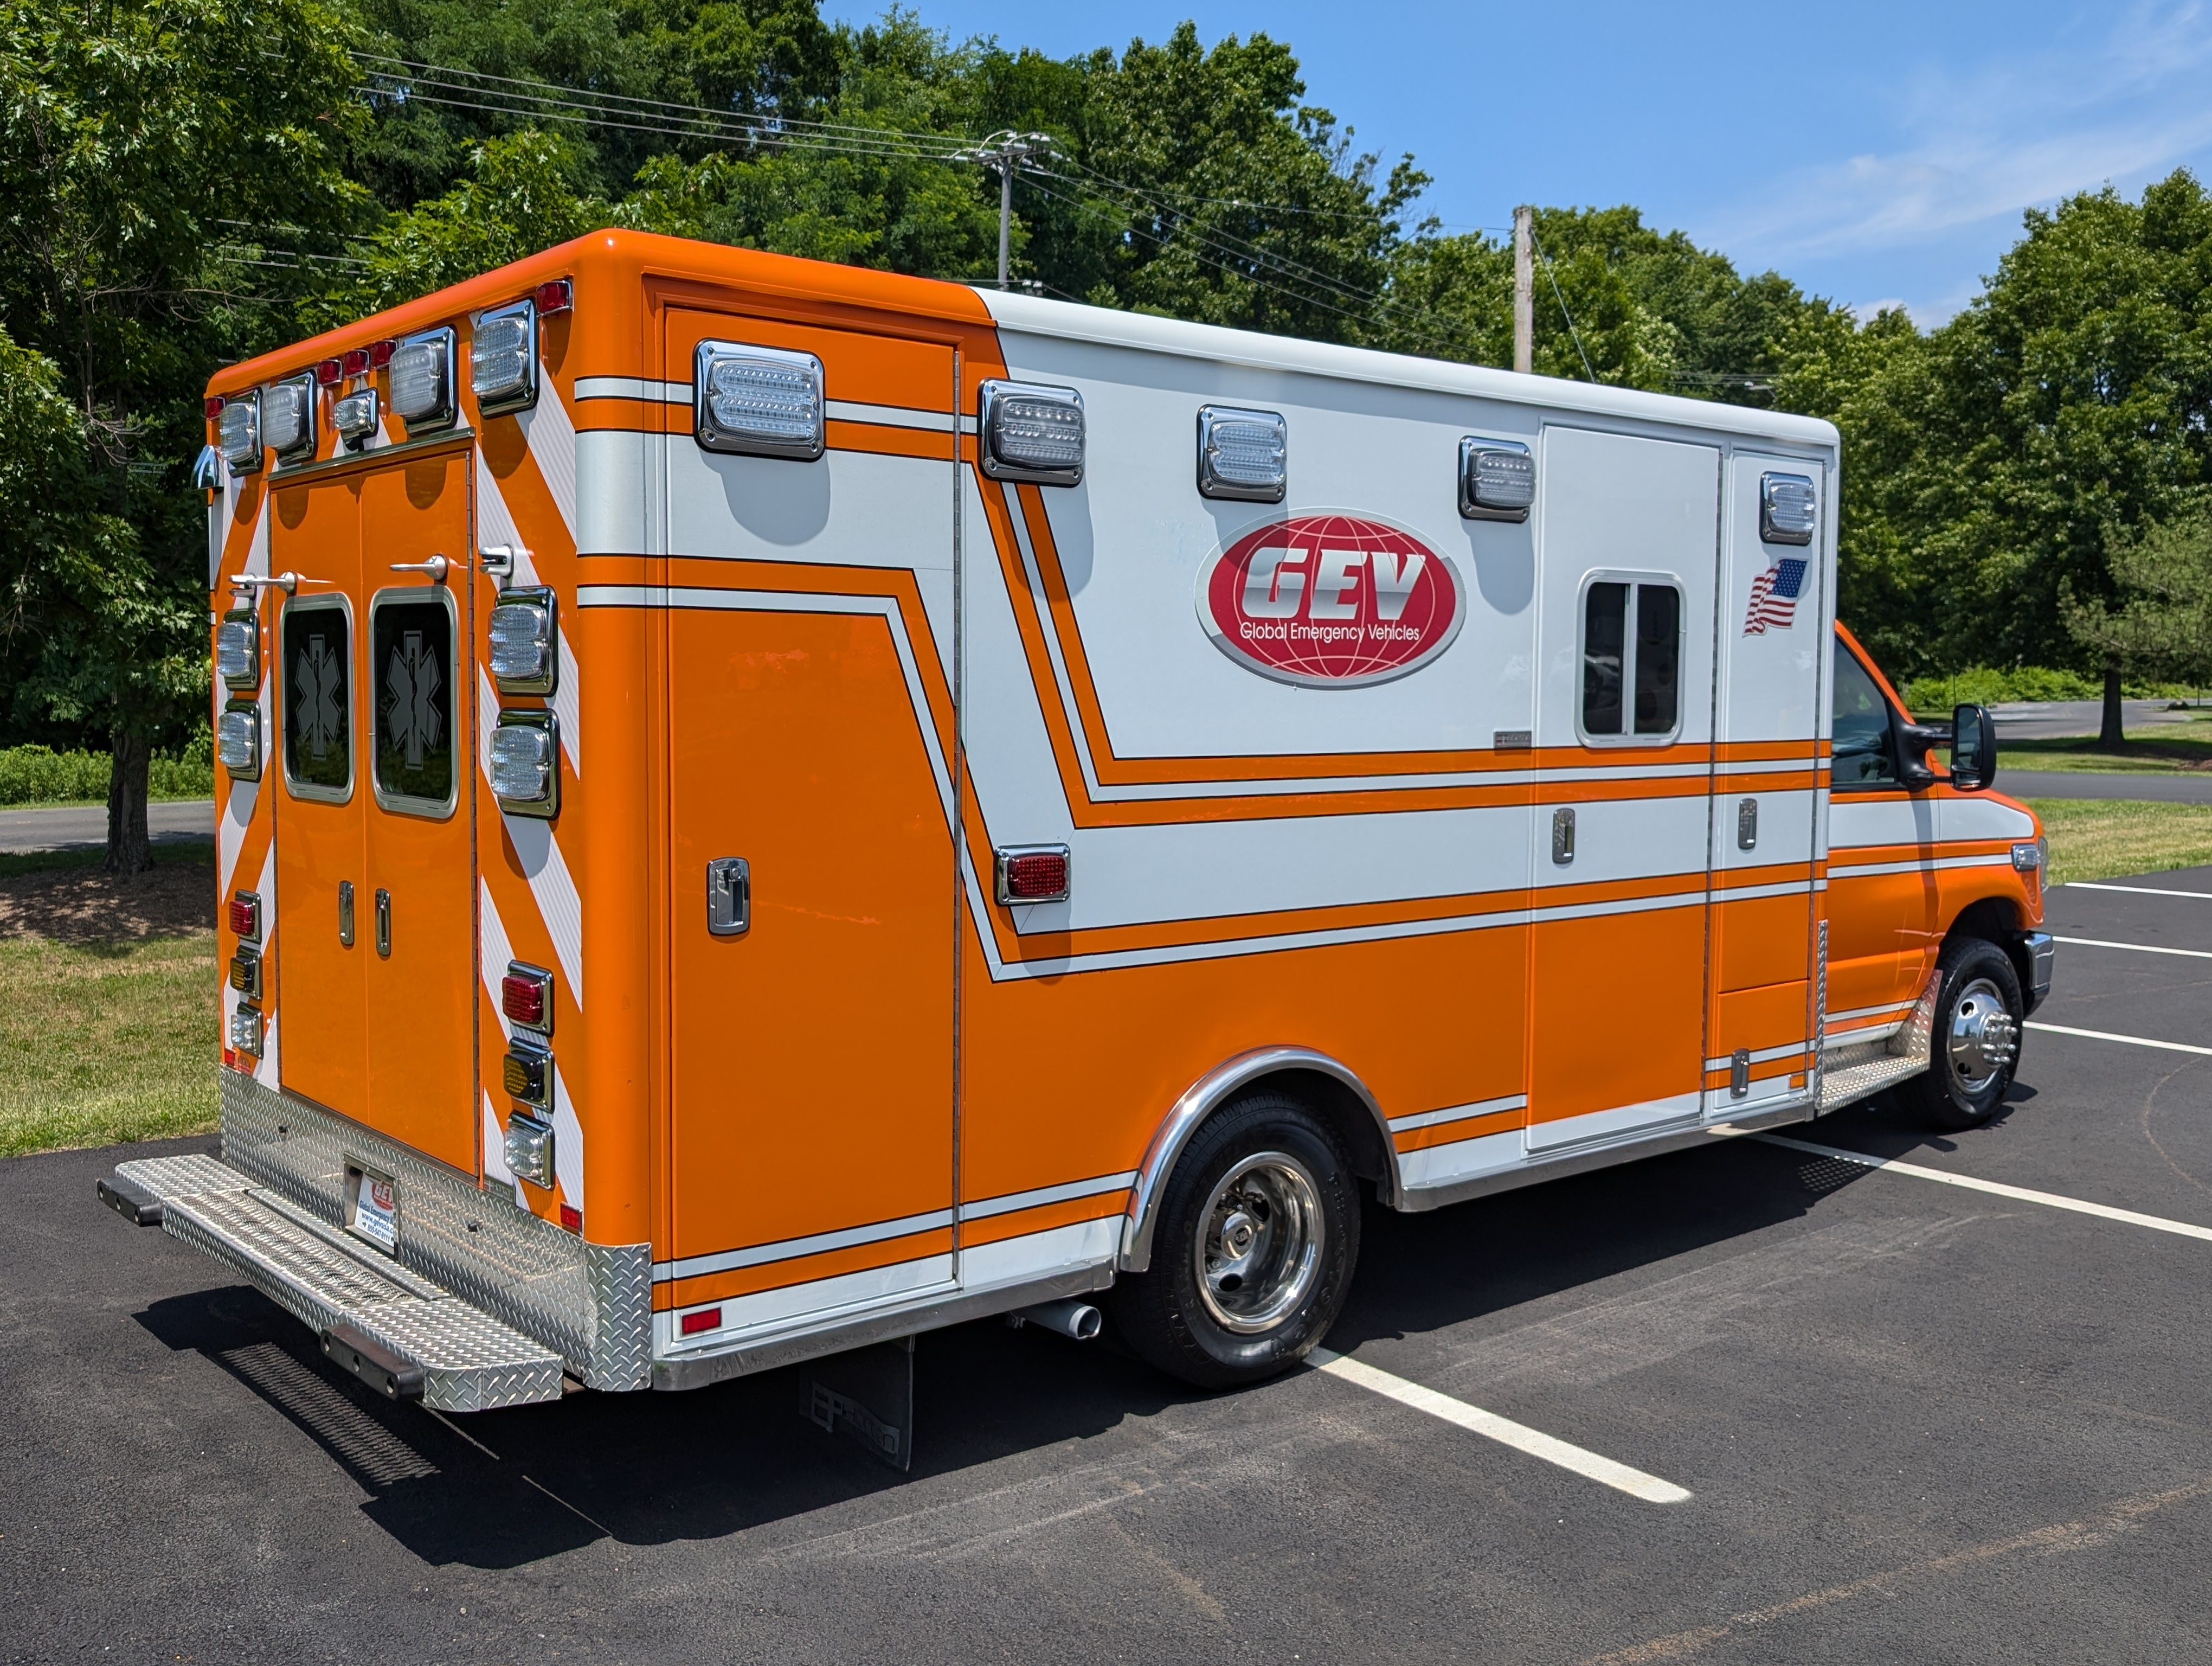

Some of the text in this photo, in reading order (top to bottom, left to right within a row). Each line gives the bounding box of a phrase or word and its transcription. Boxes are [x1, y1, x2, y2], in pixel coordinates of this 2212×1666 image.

[1242, 547, 1426, 620] GEV
[1240, 621, 1419, 644] Global Emergency Vehicles
[362, 1212, 394, 1233] www.gevusa.c
